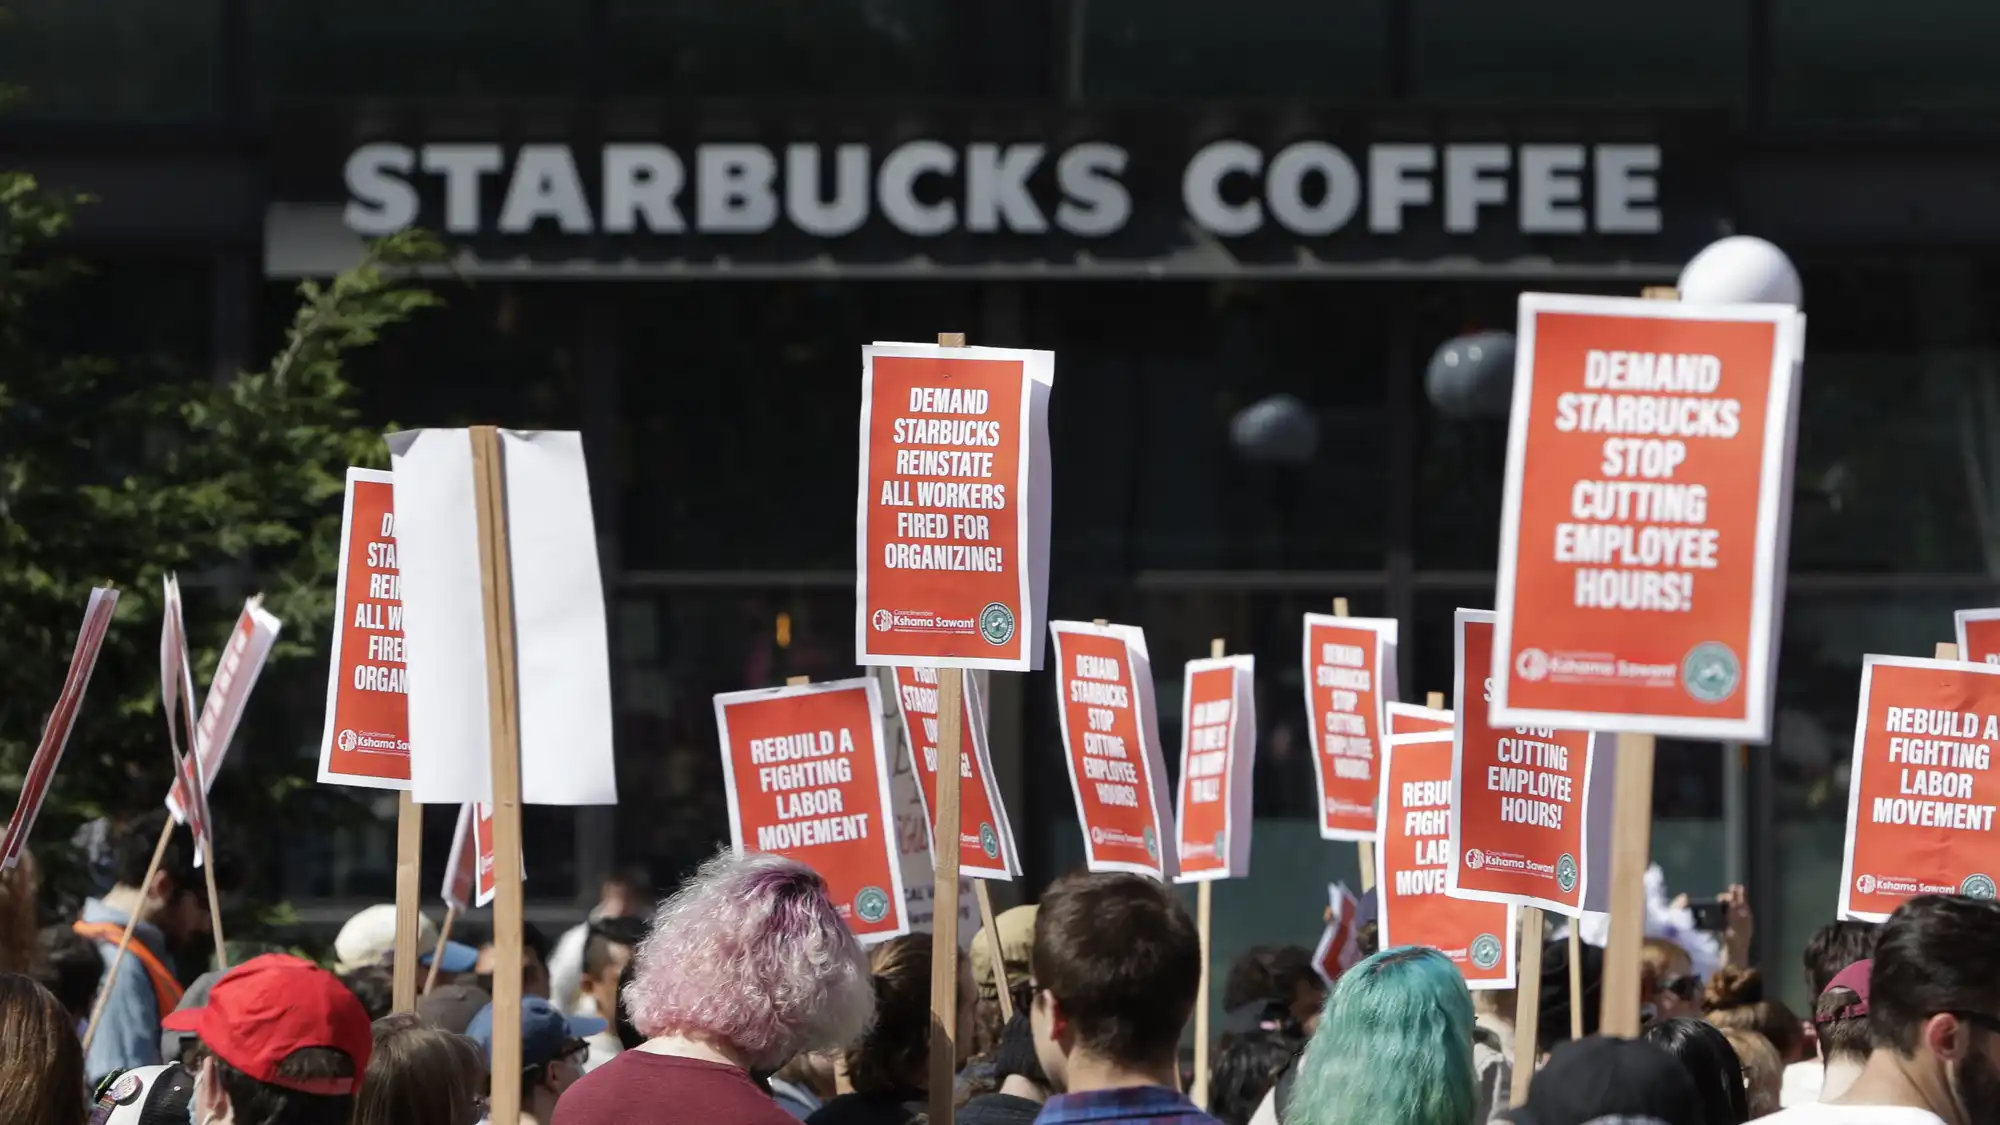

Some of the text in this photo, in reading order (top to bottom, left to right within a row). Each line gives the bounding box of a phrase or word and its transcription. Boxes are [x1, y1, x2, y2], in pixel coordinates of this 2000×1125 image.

[343, 140, 1662, 237] STARBUCKS COFFEE
[1584, 350, 1722, 393] DEMAND
[909, 387, 988, 415] DEMAND
[1555, 392, 1741, 438] STARBUCKS
[893, 418, 1000, 447] STARBUCKS
[896, 449, 993, 477] REINSTATE
[1601, 437, 1686, 478] STOP
[881, 480, 1006, 509] ALL WORKERS
[1571, 479, 1708, 524] CUTTING
[897, 512, 989, 540] FIRED FOR
[884, 543, 1003, 572] ORGANIZING!
[1554, 523, 1720, 568] EMPLOYEE
[1574, 567, 1693, 612] HOURS!
[354, 603, 385, 630] ALL
[893, 615, 975, 628] Kshama Sawant
[1075, 654, 1119, 681] DEMAND
[1070, 680, 1128, 708] STARBUCKS
[1087, 707, 1114, 732] STOP
[1886, 706, 1999, 741] REBUILD A
[357, 736, 395, 749] Kshama
[750, 727, 855, 765] REBUILD A
[1083, 731, 1127, 758] CUTTING
[1497, 737, 1568, 771] CUTTING
[1888, 737, 1991, 770] FIGHTING
[759, 757, 852, 792] FIGHTING
[1082, 756, 1139, 784] EMPLOYEE
[1488, 765, 1572, 802] EMPLOYEE
[1900, 768, 1974, 799] LABOR
[776, 788, 843, 820] LABOR
[1501, 797, 1562, 830] HOURS!
[1872, 797, 1997, 831] MOVEMENT
[757, 813, 869, 851] MOVEMENT
[1485, 855, 1525, 869] Kshama
[1526, 860, 1555, 874] Sawant
[1876, 880, 1917, 892] Kshama
[1918, 883, 1955, 894] Sawant
